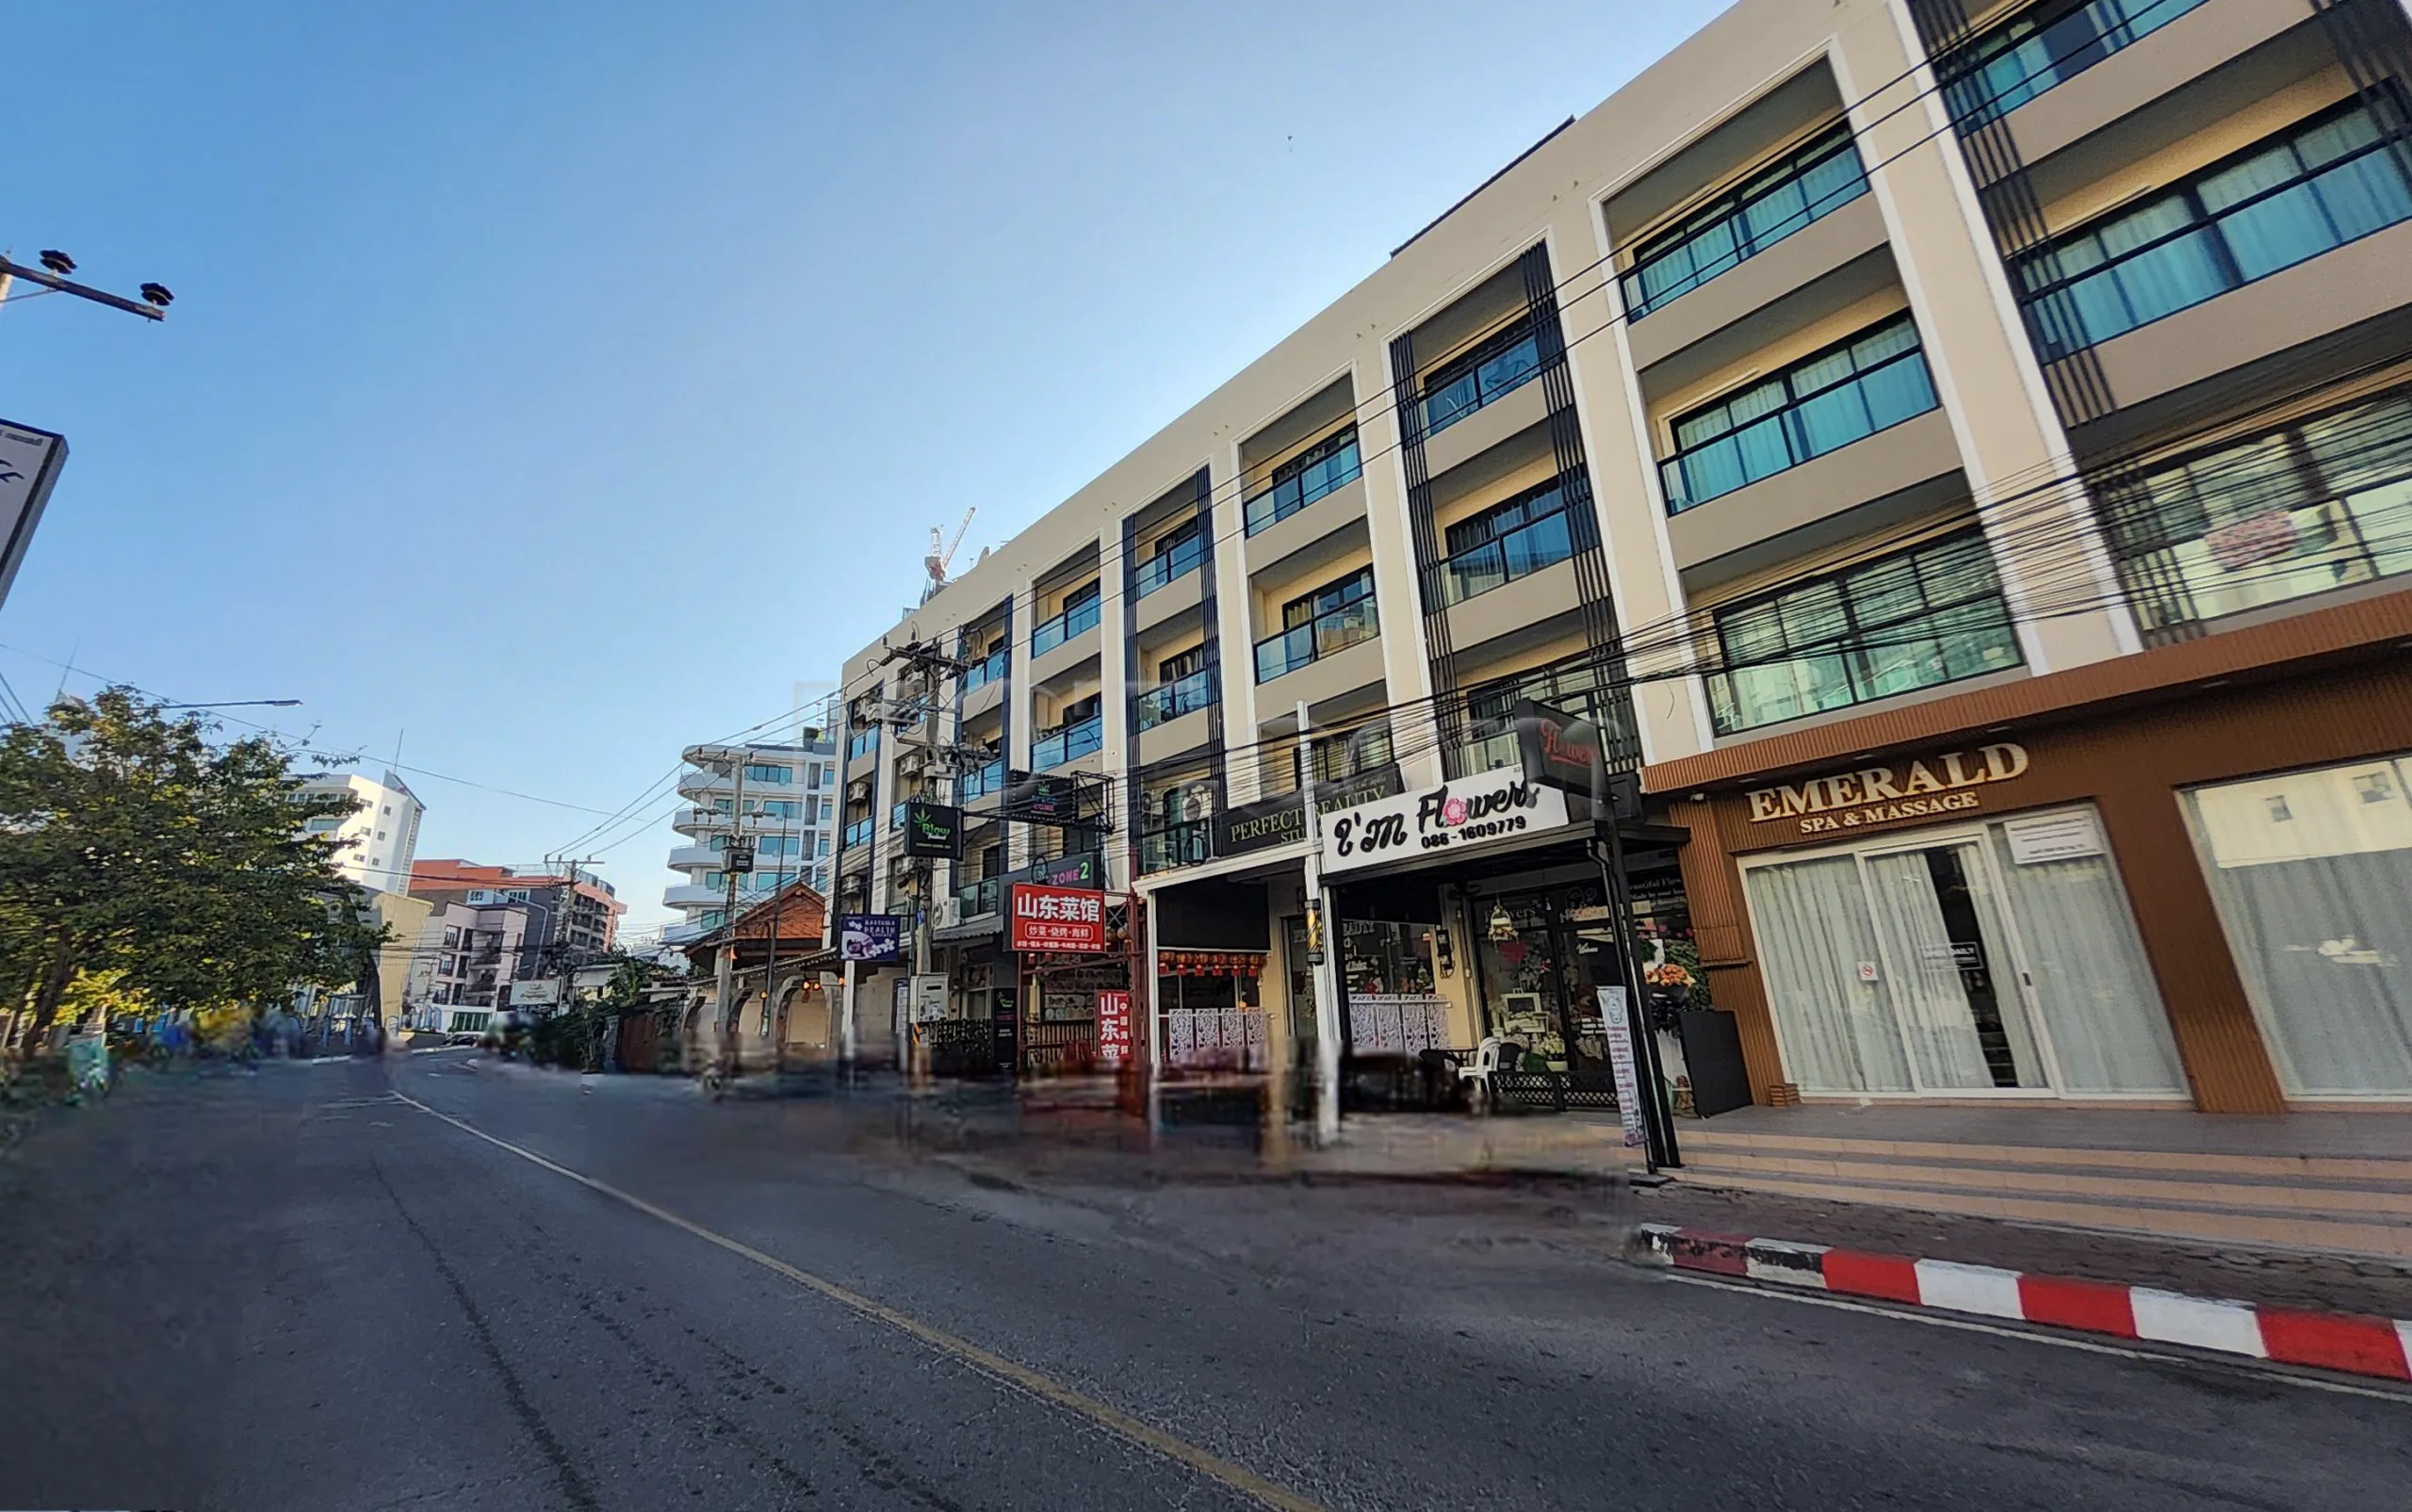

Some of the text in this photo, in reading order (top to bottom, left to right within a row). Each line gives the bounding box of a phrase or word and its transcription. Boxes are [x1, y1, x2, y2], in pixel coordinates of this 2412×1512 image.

[1745, 741, 2030, 823] EMERALD
[1230, 807, 1304, 842] PERFECT
[1801, 790, 1980, 834] SPA & MASSAGE
[1051, 861, 1089, 885] ZONE 2
[1017, 892, 1100, 923] 山东菜馆
